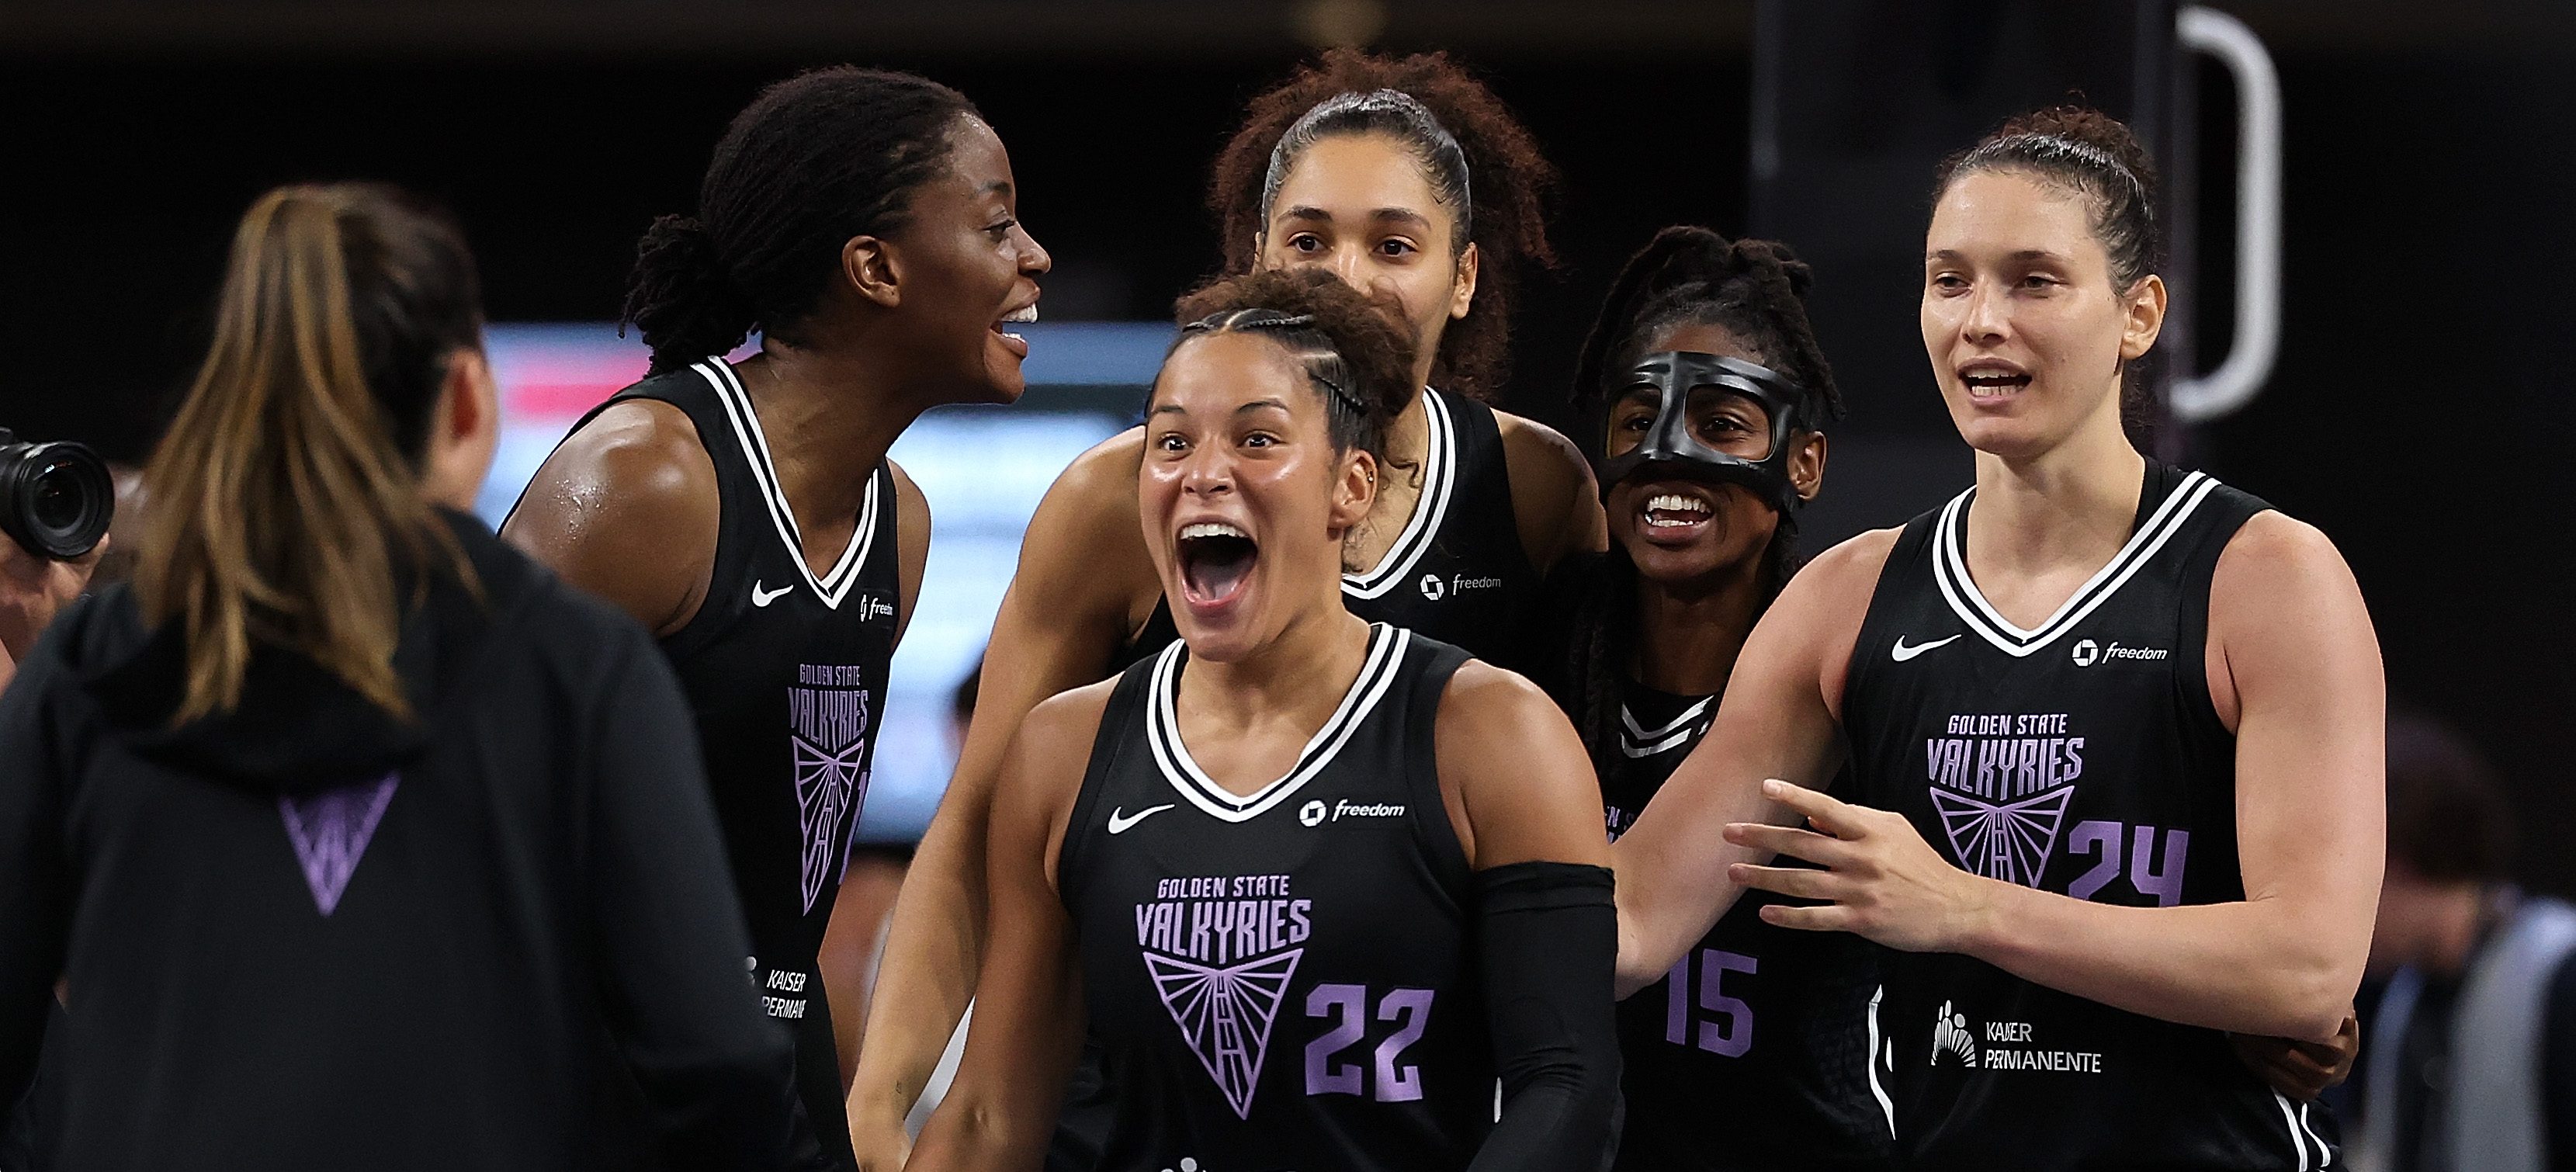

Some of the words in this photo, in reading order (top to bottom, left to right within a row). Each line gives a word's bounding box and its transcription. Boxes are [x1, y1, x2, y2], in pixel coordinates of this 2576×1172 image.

[1452, 573, 1501, 596] freedom
[2101, 641, 2168, 664] freedom
[799, 664, 833, 686] GOLDEN
[836, 665, 861, 687] STATE
[787, 686, 868, 753] VALKYRIES
[1947, 714, 2012, 737] GOLDEN
[2016, 713, 2068, 736] STATE
[1926, 737, 2085, 801] VALKYRIES
[1331, 798, 1406, 823] freedom
[2068, 820, 2189, 909] 24
[1156, 876, 1227, 900] GOLDEN
[1232, 874, 1291, 897] STATE
[1135, 899, 1312, 965] VALKYRIES
[766, 969, 806, 992] KAISER
[1666, 948, 1758, 1059] 15
[1305, 983, 1435, 1102] 22
